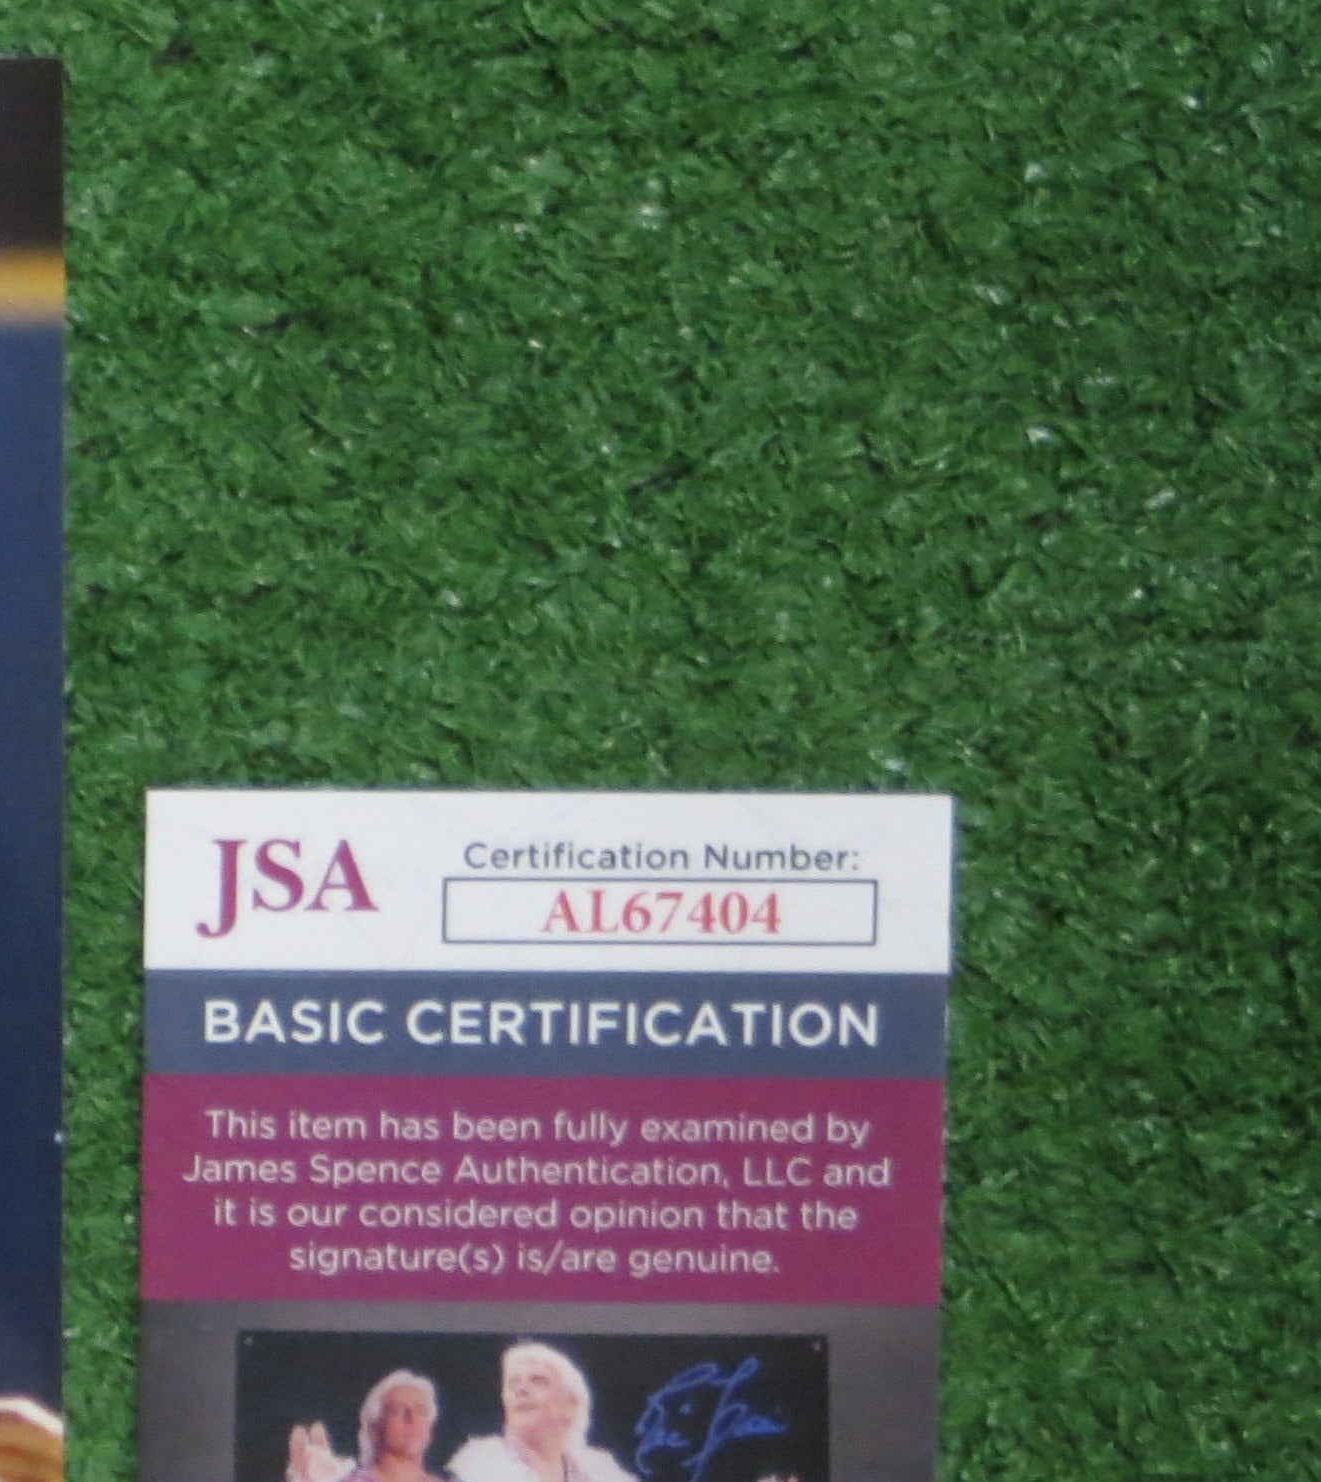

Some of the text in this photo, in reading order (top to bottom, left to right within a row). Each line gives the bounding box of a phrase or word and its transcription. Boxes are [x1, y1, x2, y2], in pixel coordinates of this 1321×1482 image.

[464, 841, 858, 872] Certification Number:
[195, 838, 379, 939] JSA
[540, 889, 781, 934] AL67404
[204, 998, 878, 1047] BASIC CERTIFICATION
[205, 1108, 871, 1149] This item has been fully examined by
[182, 1152, 892, 1189] James Spence Authentication, LLC and
[214, 1197, 859, 1233] it is our considered opinion that the
[289, 1240, 779, 1279] signature(s) is/are genuine.
